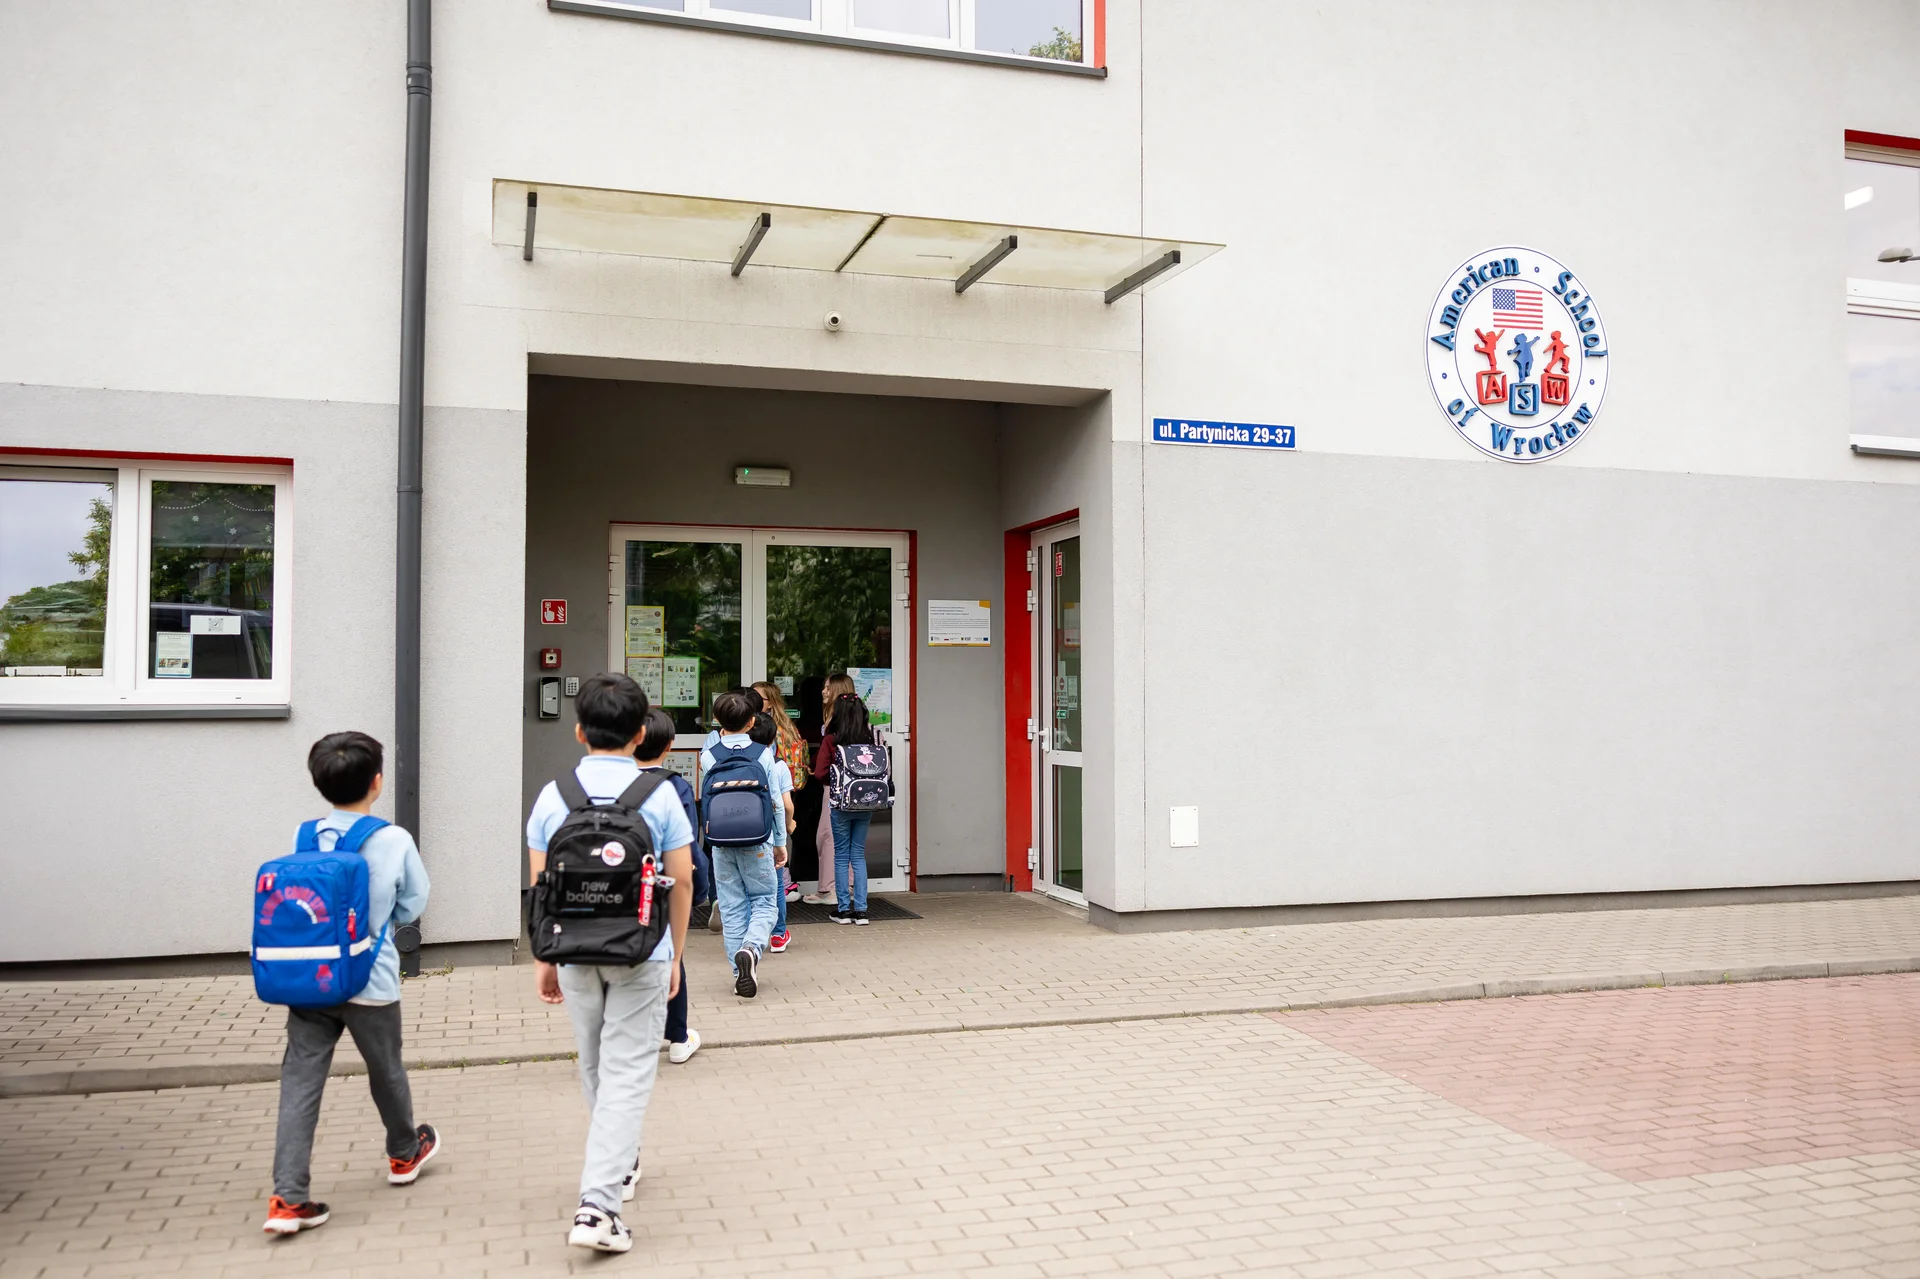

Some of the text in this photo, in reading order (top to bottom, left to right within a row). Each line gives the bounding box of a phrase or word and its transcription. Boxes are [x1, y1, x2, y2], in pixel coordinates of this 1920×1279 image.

[1430, 257, 1608, 358] American School
[1485, 374, 1565, 409] A S W
[1159, 422, 1292, 444] ul. Partynicka 29-37
[1447, 398, 1593, 455] of Wrocław
[566, 890, 624, 904] balance
[581, 881, 610, 892] new
